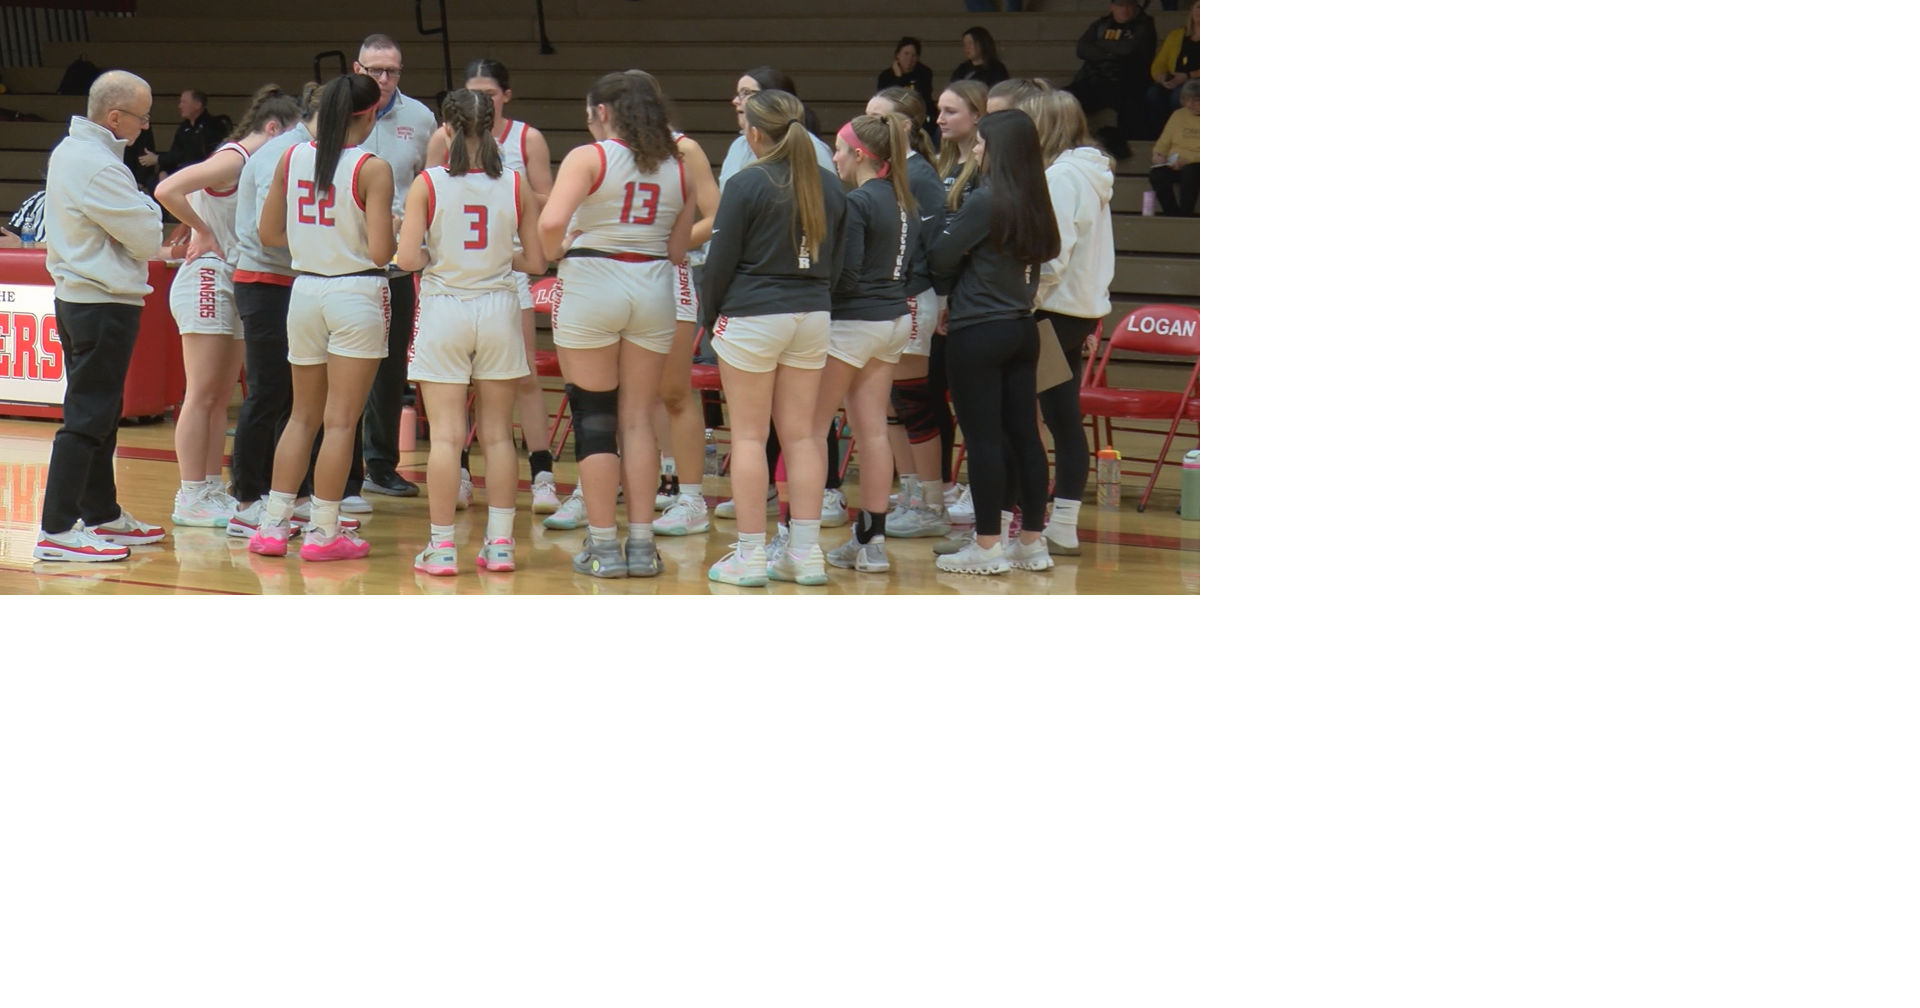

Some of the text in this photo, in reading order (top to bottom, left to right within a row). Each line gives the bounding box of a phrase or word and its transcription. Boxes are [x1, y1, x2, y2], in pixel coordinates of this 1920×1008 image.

[297, 179, 336, 227] 22
[619, 181, 661, 225] 13
[463, 204, 488, 250] 3
[199, 267, 216, 319] RANGERS
[678, 258, 693, 306] RANGER
[1127, 315, 1197, 337] LOGAN
